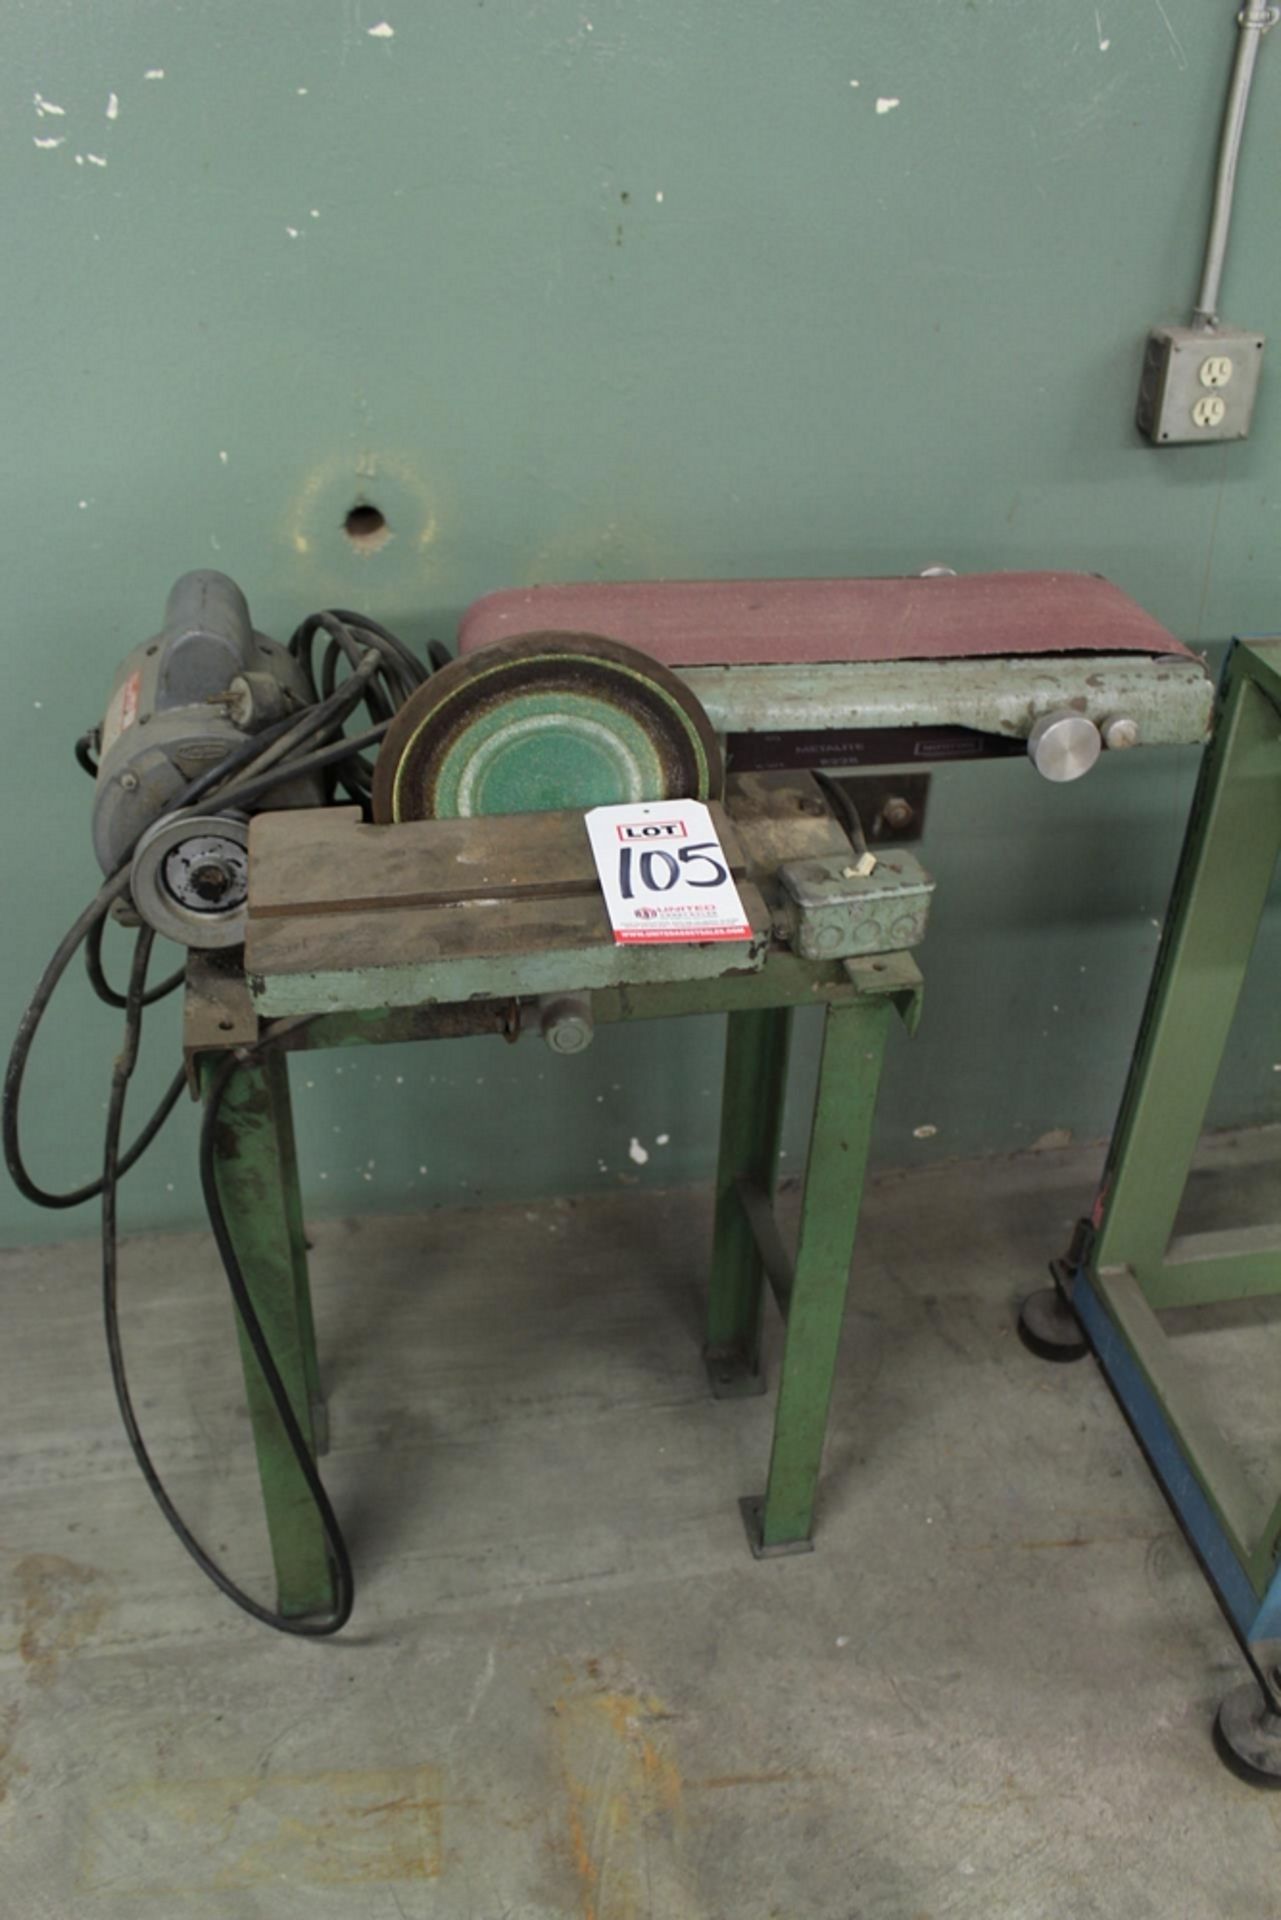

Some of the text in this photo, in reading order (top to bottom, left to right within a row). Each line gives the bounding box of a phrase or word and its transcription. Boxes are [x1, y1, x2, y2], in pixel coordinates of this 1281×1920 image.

[795, 743, 865, 754] METALITE
[625, 824, 677, 838] LOT
[619, 842, 727, 899] 105
